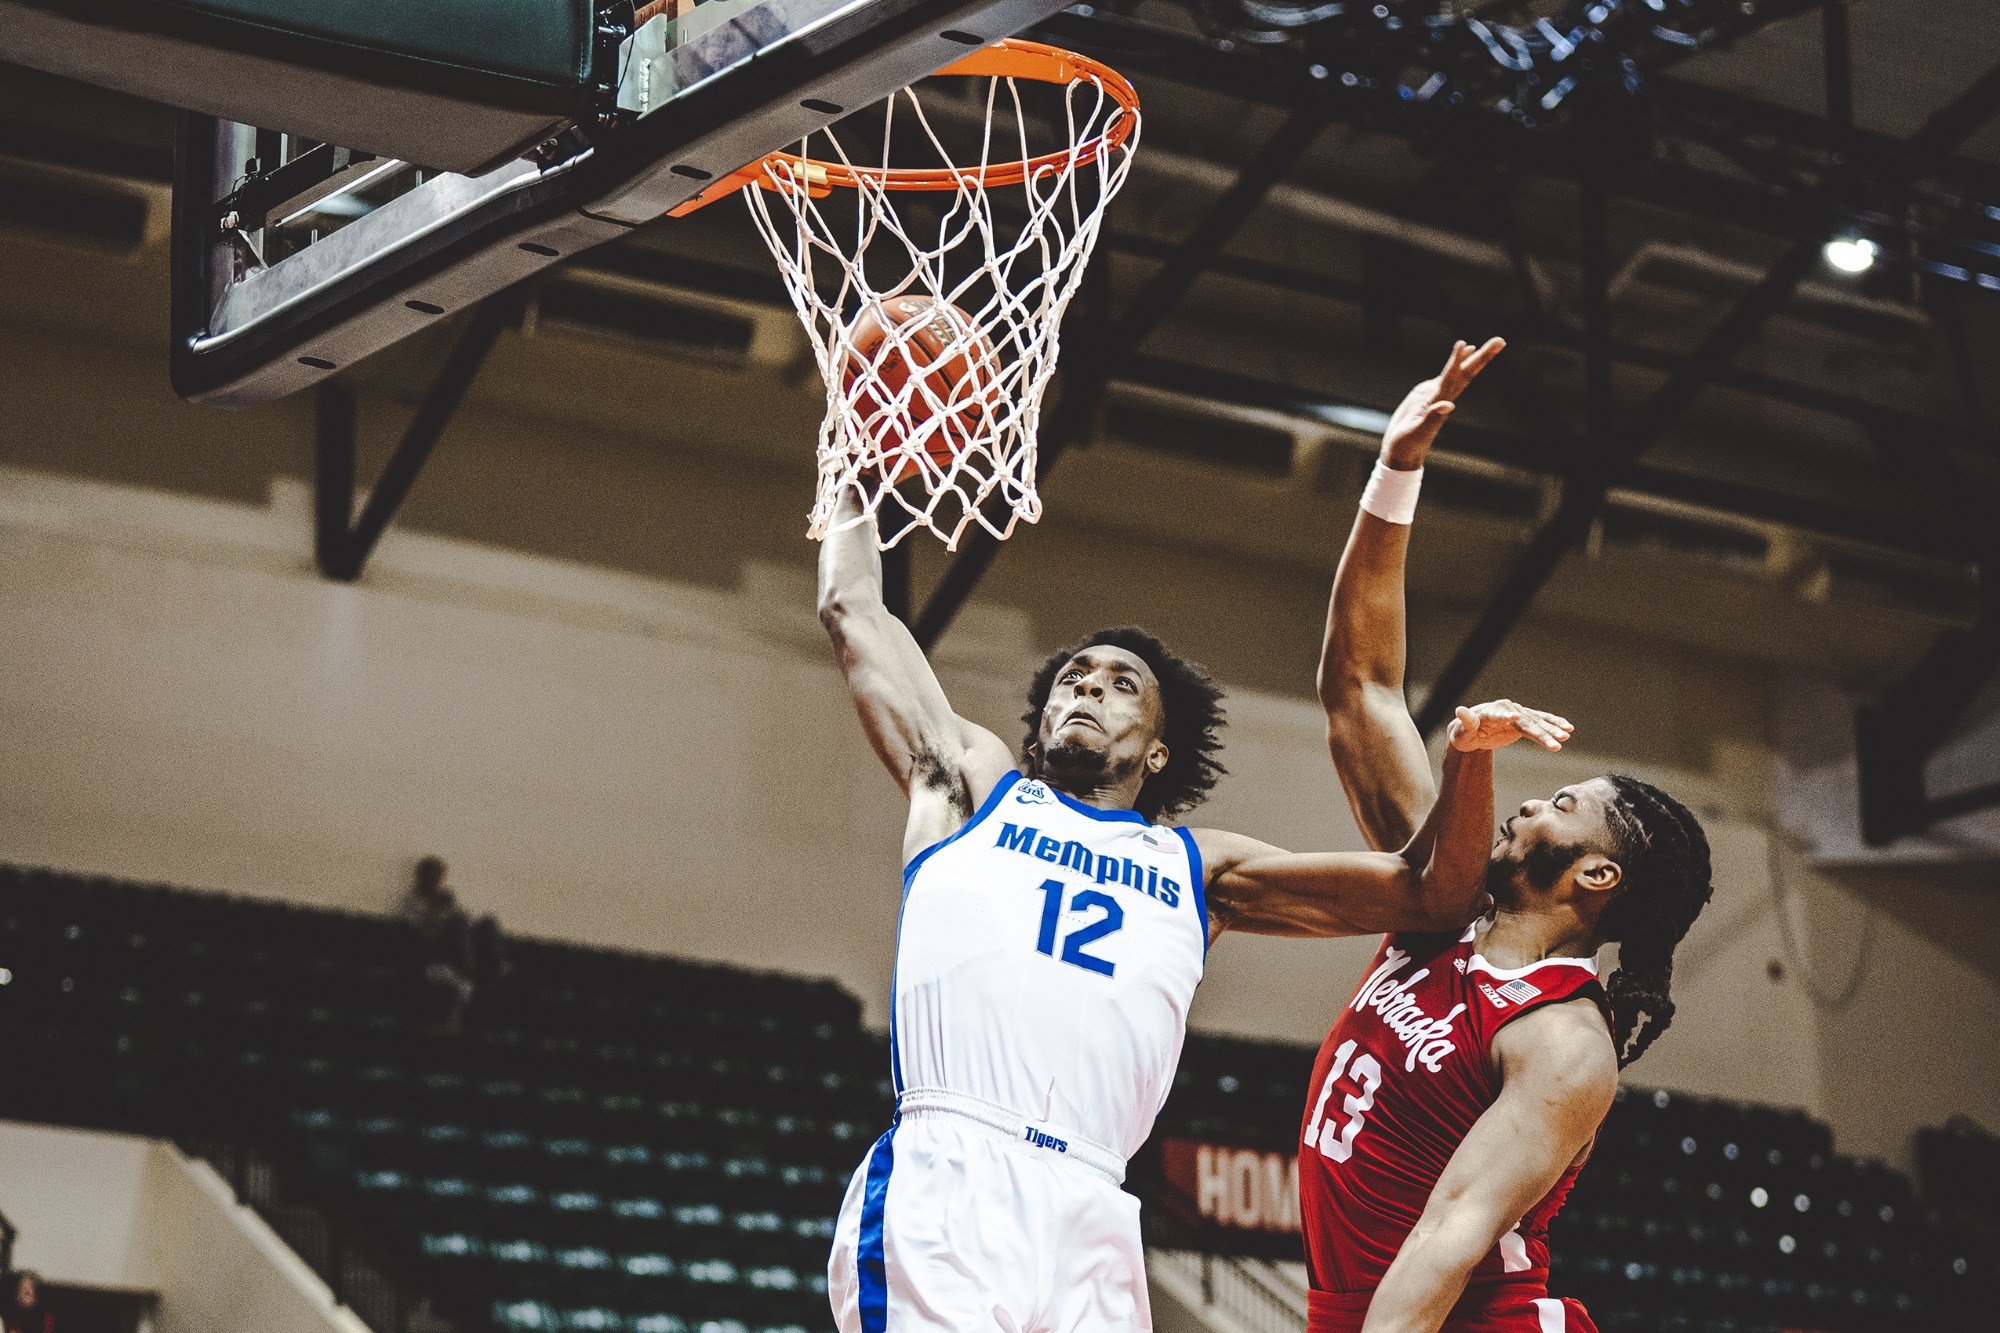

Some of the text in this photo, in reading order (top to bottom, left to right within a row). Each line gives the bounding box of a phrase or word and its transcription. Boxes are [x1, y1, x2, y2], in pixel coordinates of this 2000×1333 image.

[992, 821, 1181, 909] Memphis
[1035, 878, 1125, 979] 12
[1348, 946, 1467, 1073] Nebraska
[1024, 1126, 1068, 1153] Tigers
[1303, 1039, 1382, 1164] 13
